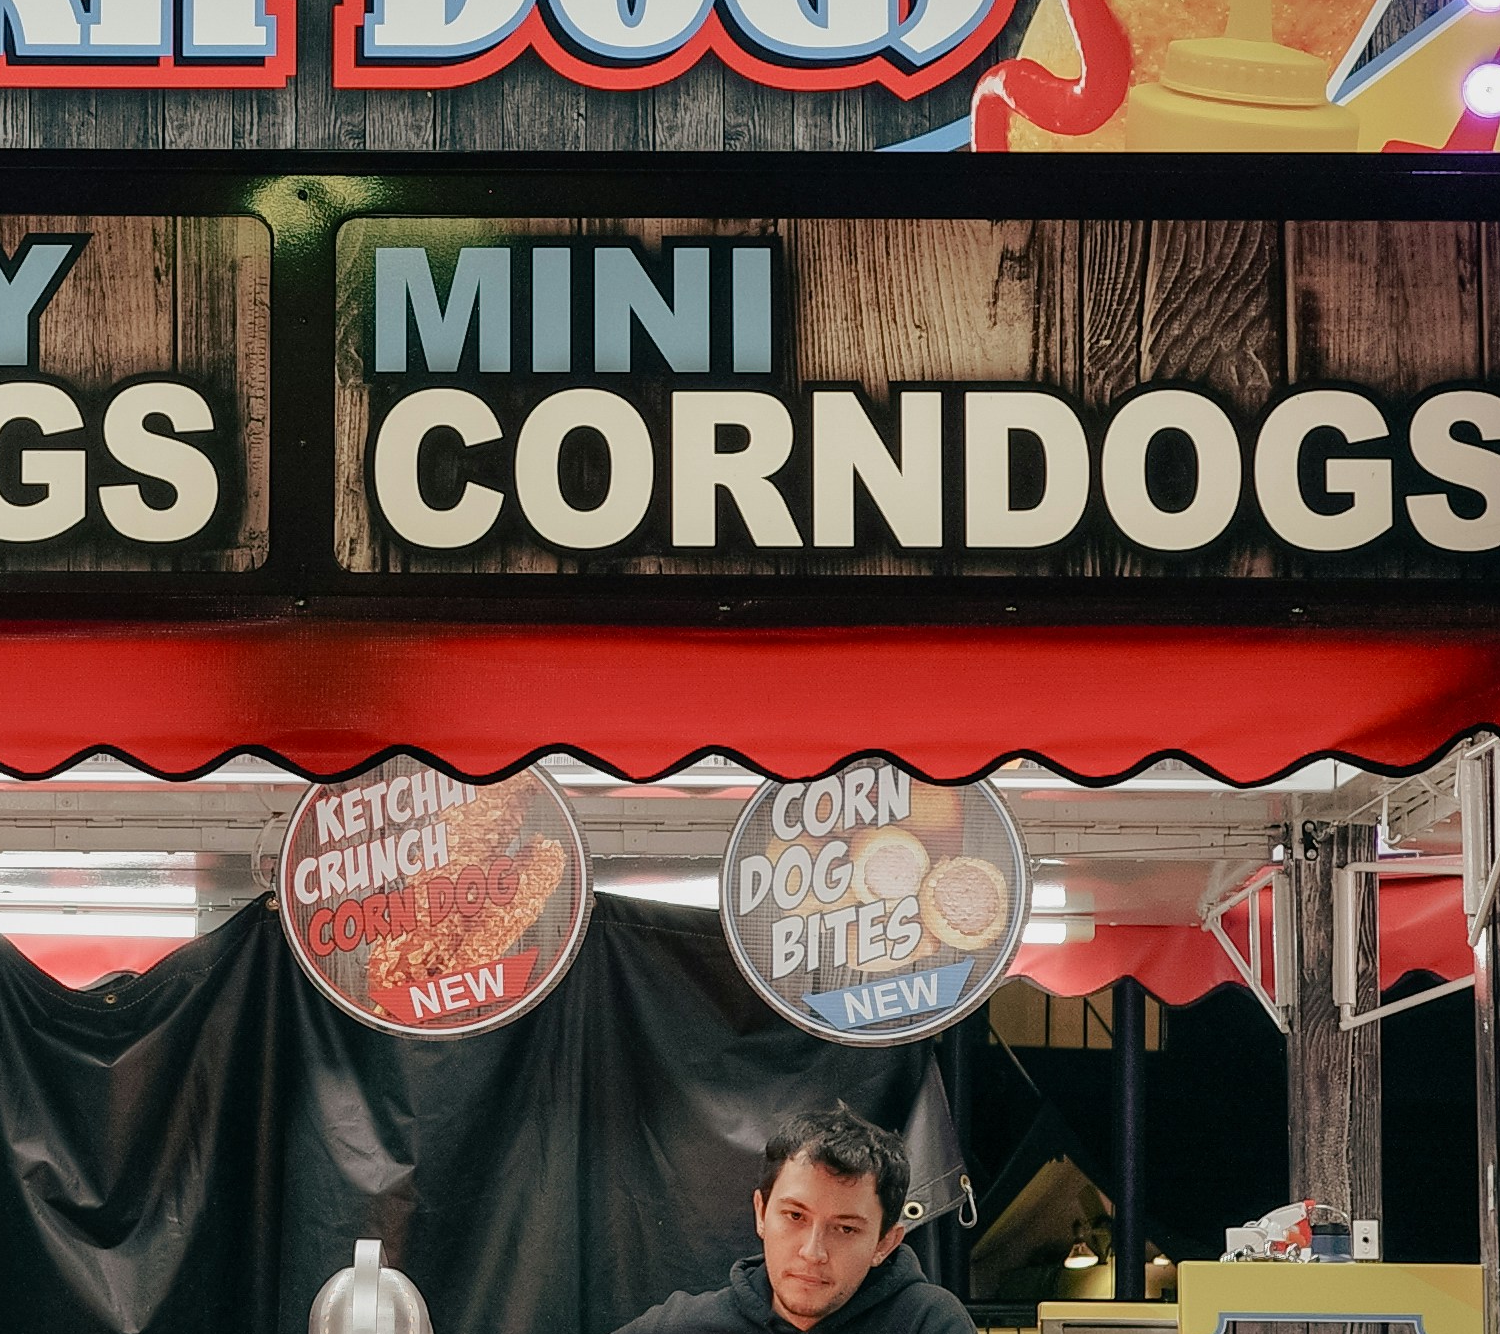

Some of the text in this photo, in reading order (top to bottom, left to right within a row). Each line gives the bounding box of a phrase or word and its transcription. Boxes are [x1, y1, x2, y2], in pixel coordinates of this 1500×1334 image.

[373, 245, 774, 373] MINI
[771, 765, 912, 842] CORN
[293, 821, 450, 905] CRUNCH
[739, 840, 855, 917] DOG
[307, 855, 521, 957] CORN DOG
[770, 895, 923, 981] BITES
[408, 964, 505, 1019] NEW
[842, 973, 939, 1025] NEW
